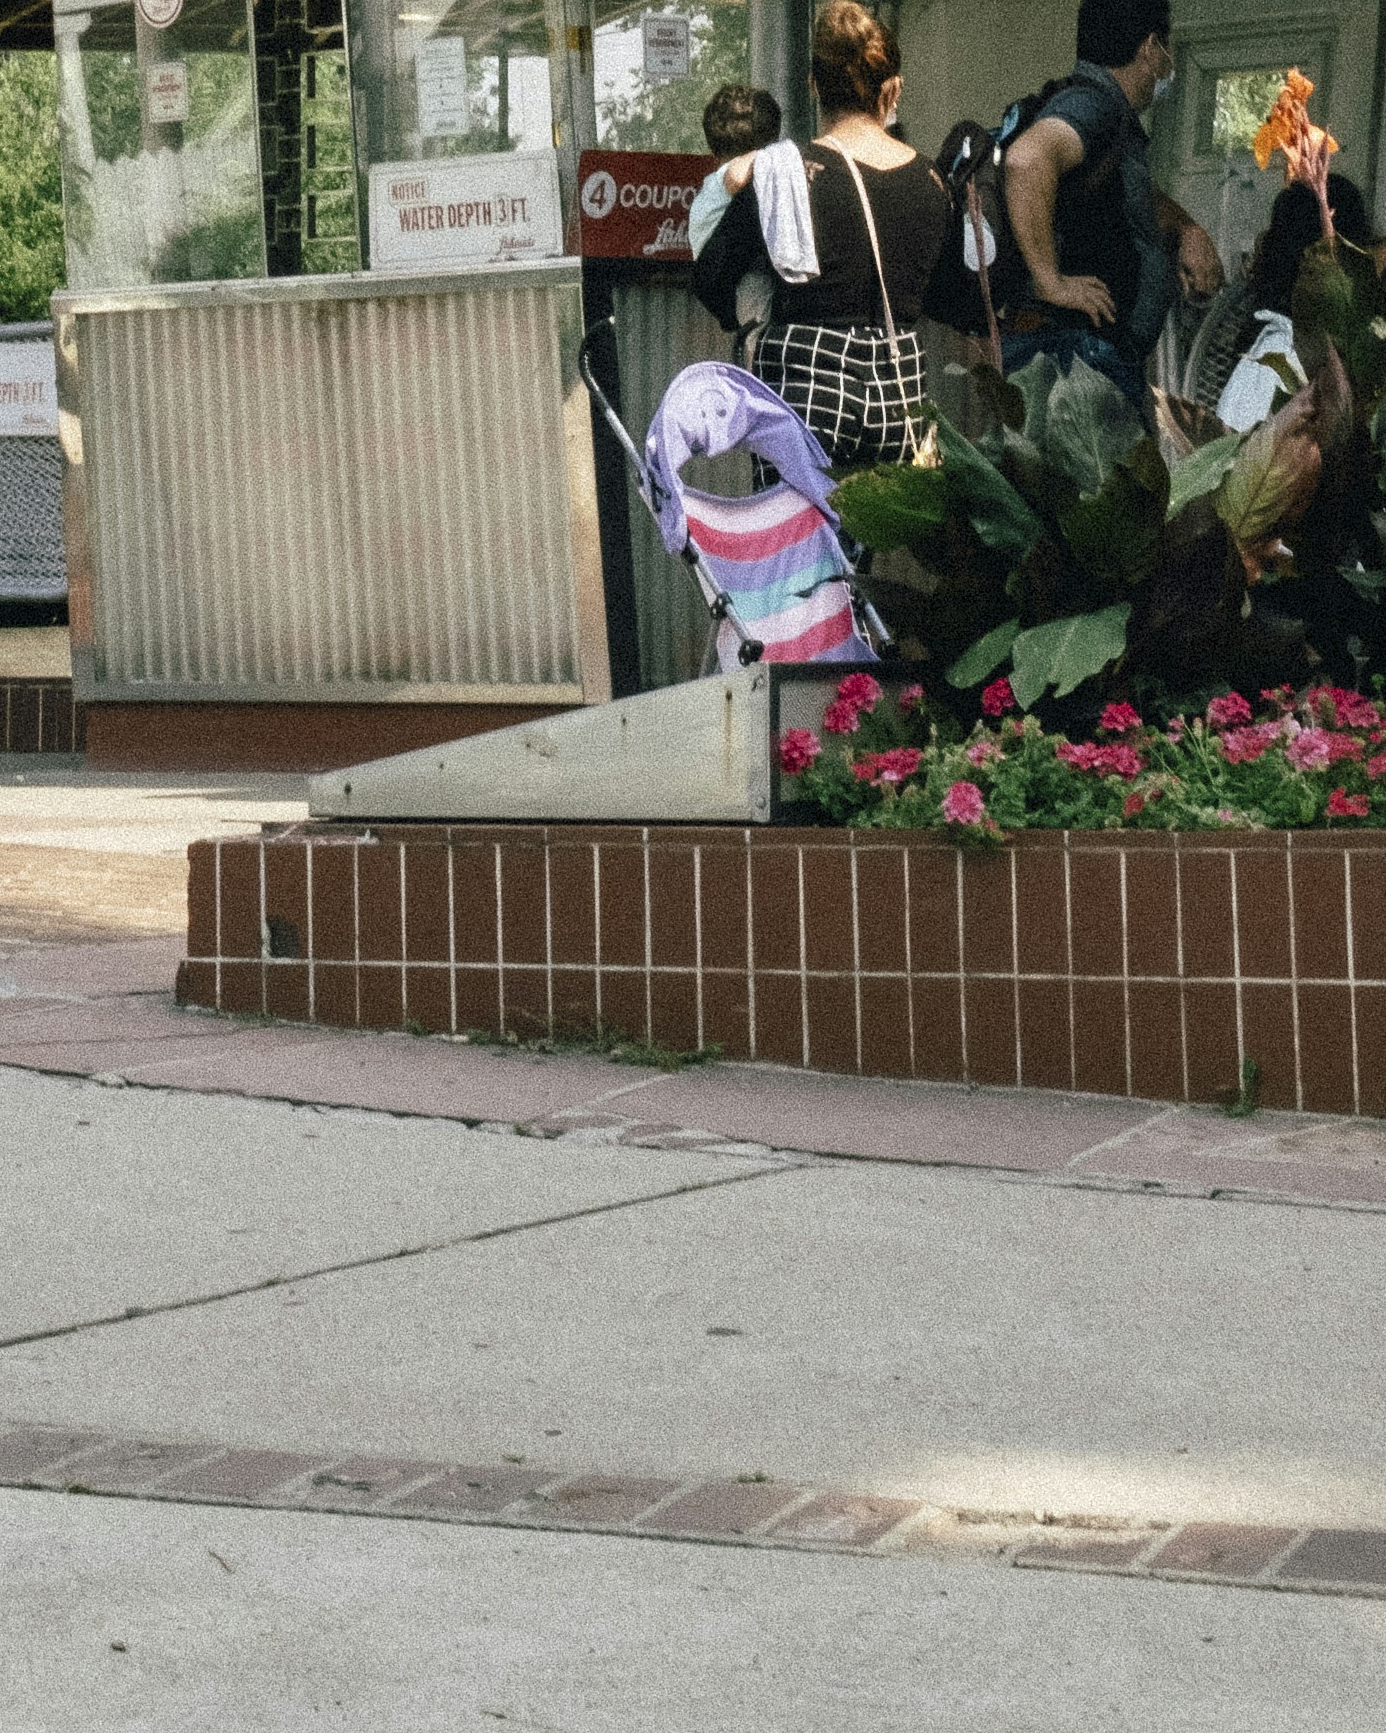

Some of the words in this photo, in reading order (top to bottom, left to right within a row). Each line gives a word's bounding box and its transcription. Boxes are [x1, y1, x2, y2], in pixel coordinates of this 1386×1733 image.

[391, 181, 426, 201] NOTICE
[588, 179, 607, 211] 4
[619, 183, 697, 210] COUPO
[399, 205, 445, 232] WATER
[447, 201, 493, 229] DEPTH
[498, 197, 508, 223] 3
